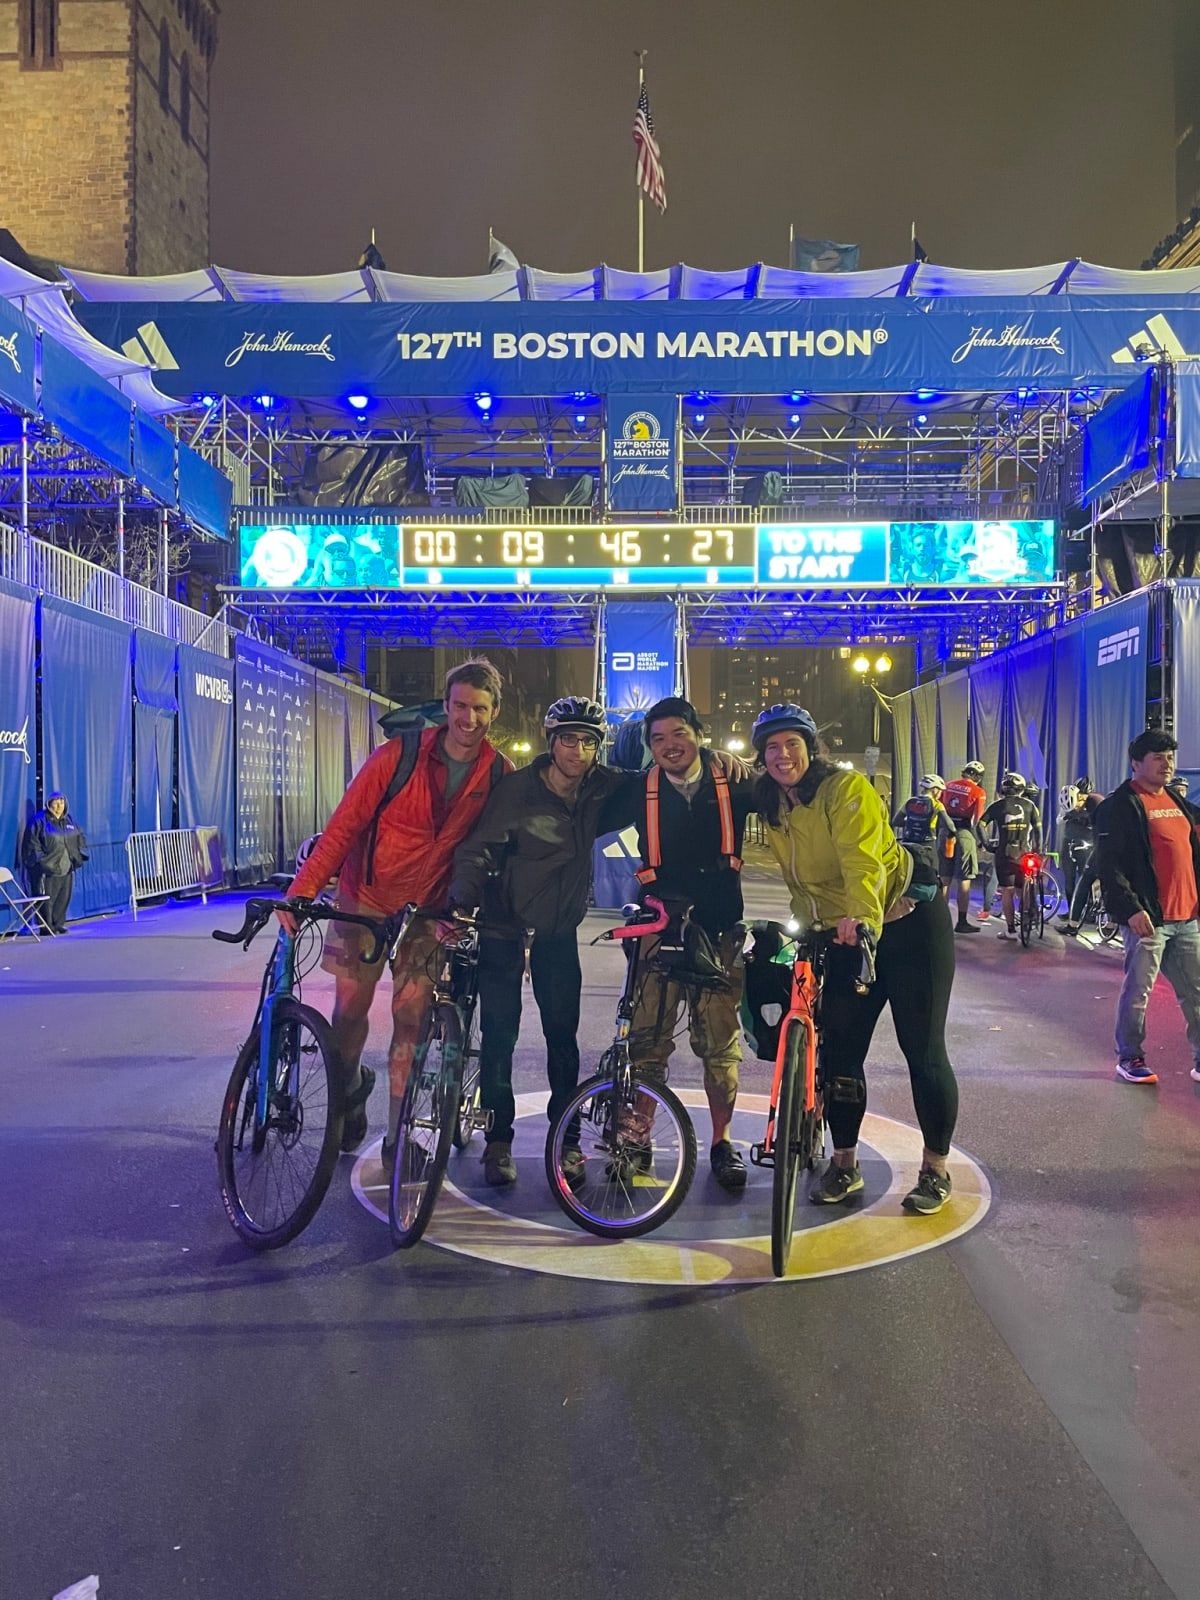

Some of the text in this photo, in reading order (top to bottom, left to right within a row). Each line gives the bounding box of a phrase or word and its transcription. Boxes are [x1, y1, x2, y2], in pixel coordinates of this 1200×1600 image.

[224, 330, 336, 368] John Hancock
[397, 332, 482, 360] 127TH
[493, 331, 645, 360] BOSTON
[951, 324, 1066, 364] John Hancock
[633, 441, 669, 449] BOSTON
[414, 530, 456, 563] 00
[502, 530, 545, 563] 09
[600, 530, 642, 563] 46
[692, 529, 734, 563] 27
[768, 530, 807, 554] TO
[768, 554, 855, 579] START
[1097, 626, 1140, 667] ESPN
